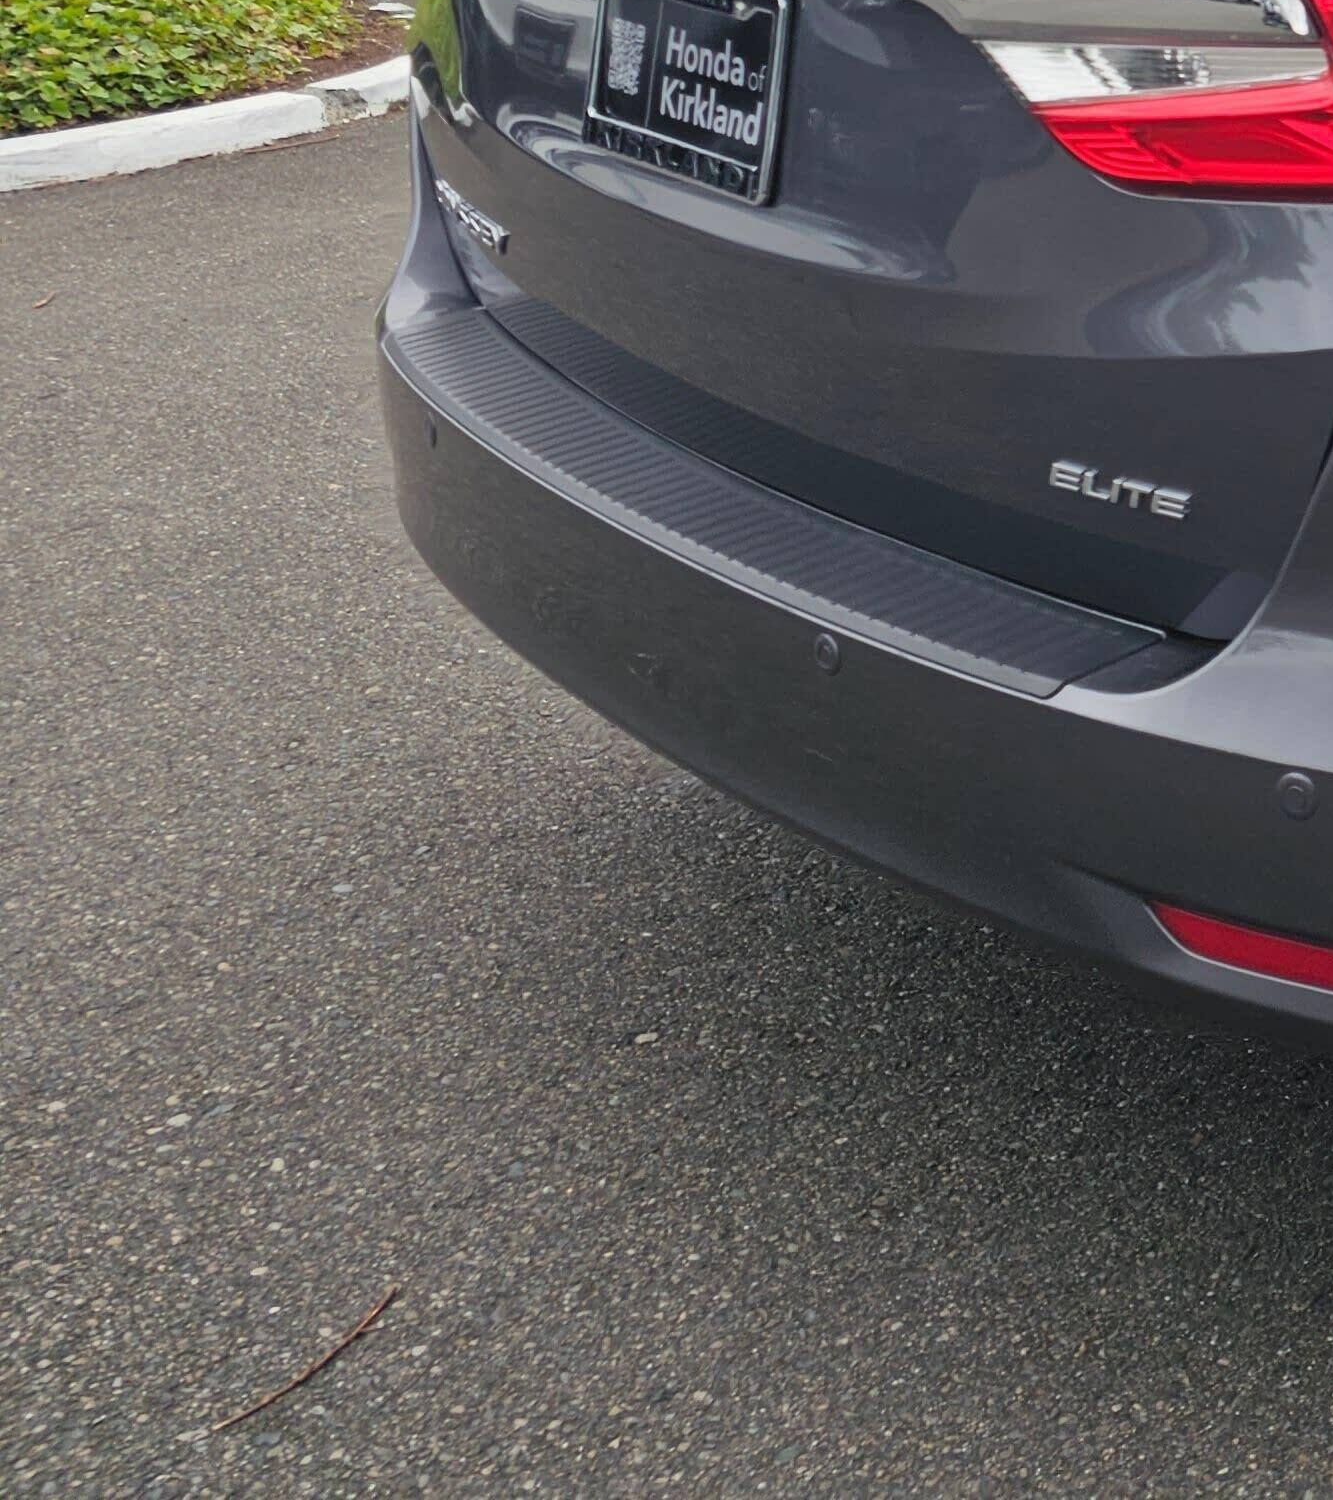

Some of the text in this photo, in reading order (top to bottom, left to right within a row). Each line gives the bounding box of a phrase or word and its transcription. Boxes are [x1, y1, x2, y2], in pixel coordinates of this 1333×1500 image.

[665, 25, 767, 93] Honda of
[659, 75, 763, 147] Kirkland
[1049, 459, 1193, 520] ELITE
